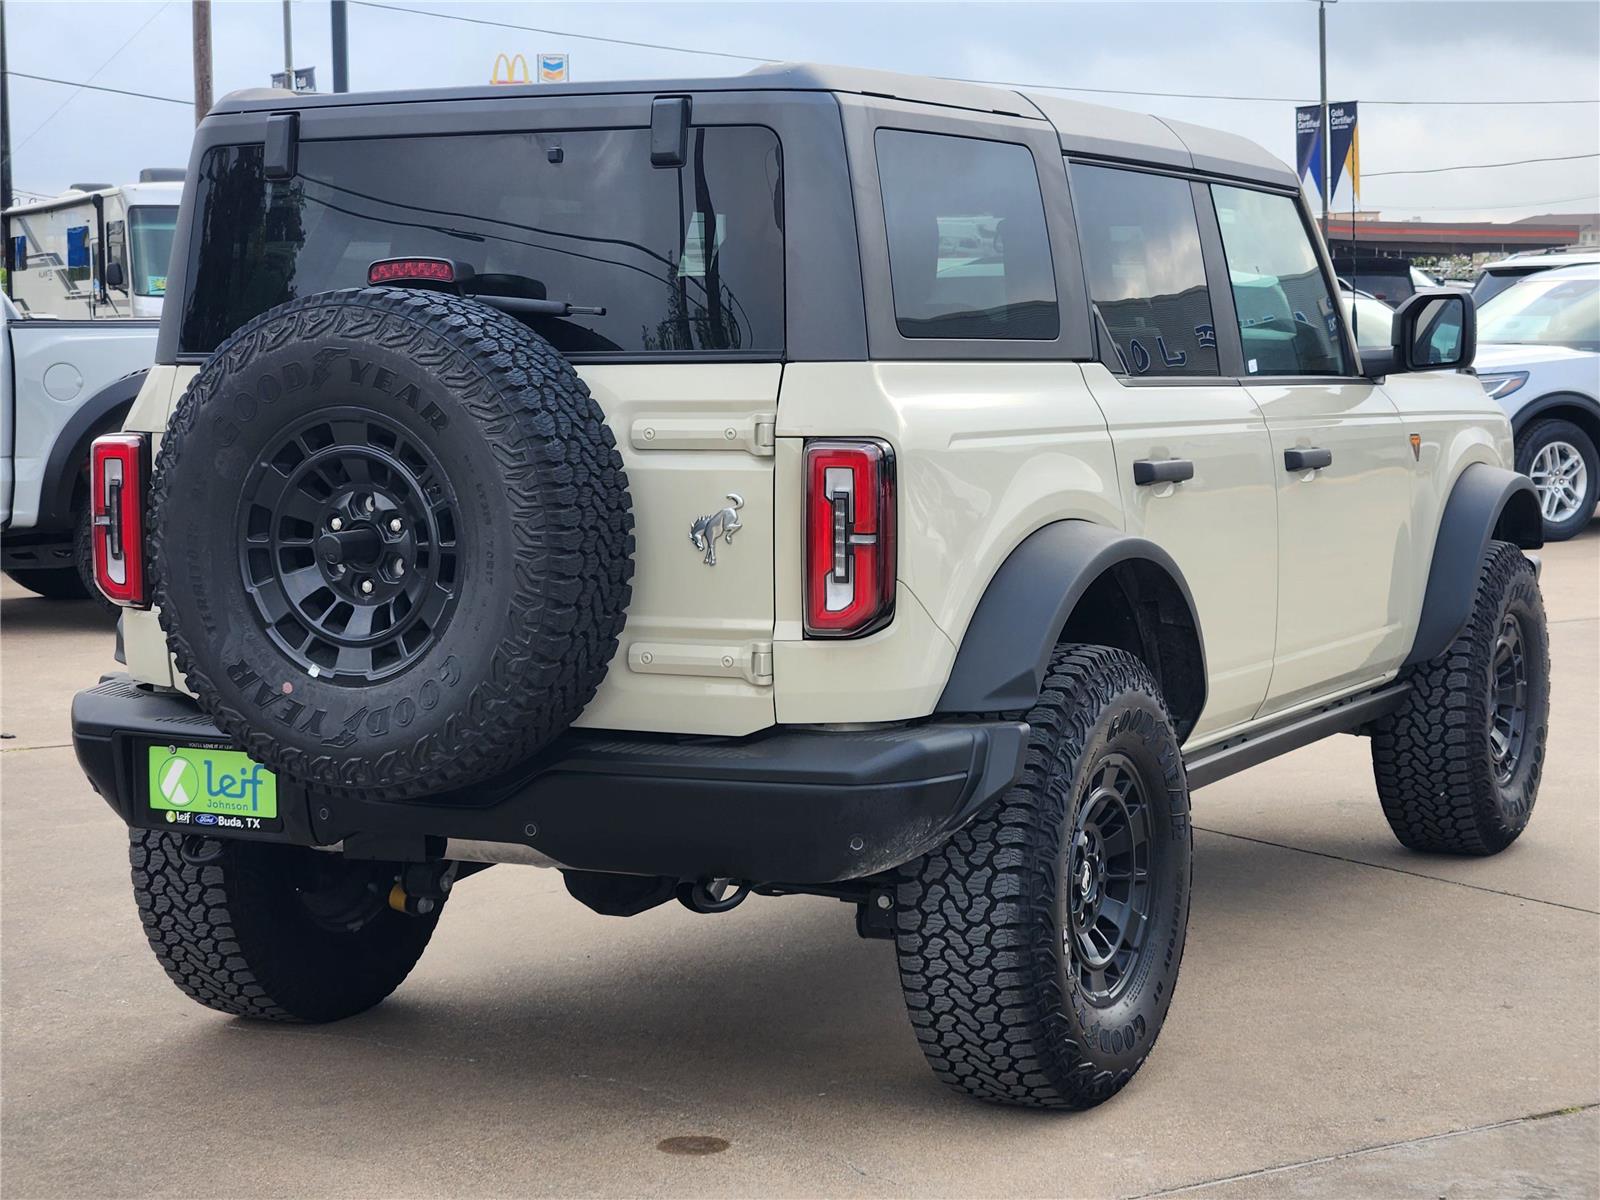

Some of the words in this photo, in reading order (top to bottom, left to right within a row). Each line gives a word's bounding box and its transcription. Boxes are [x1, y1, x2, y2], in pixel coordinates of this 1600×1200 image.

[207, 799, 249, 811] Johnson
[218, 815, 244, 829] Buda,
[246, 818, 261, 829] TX
